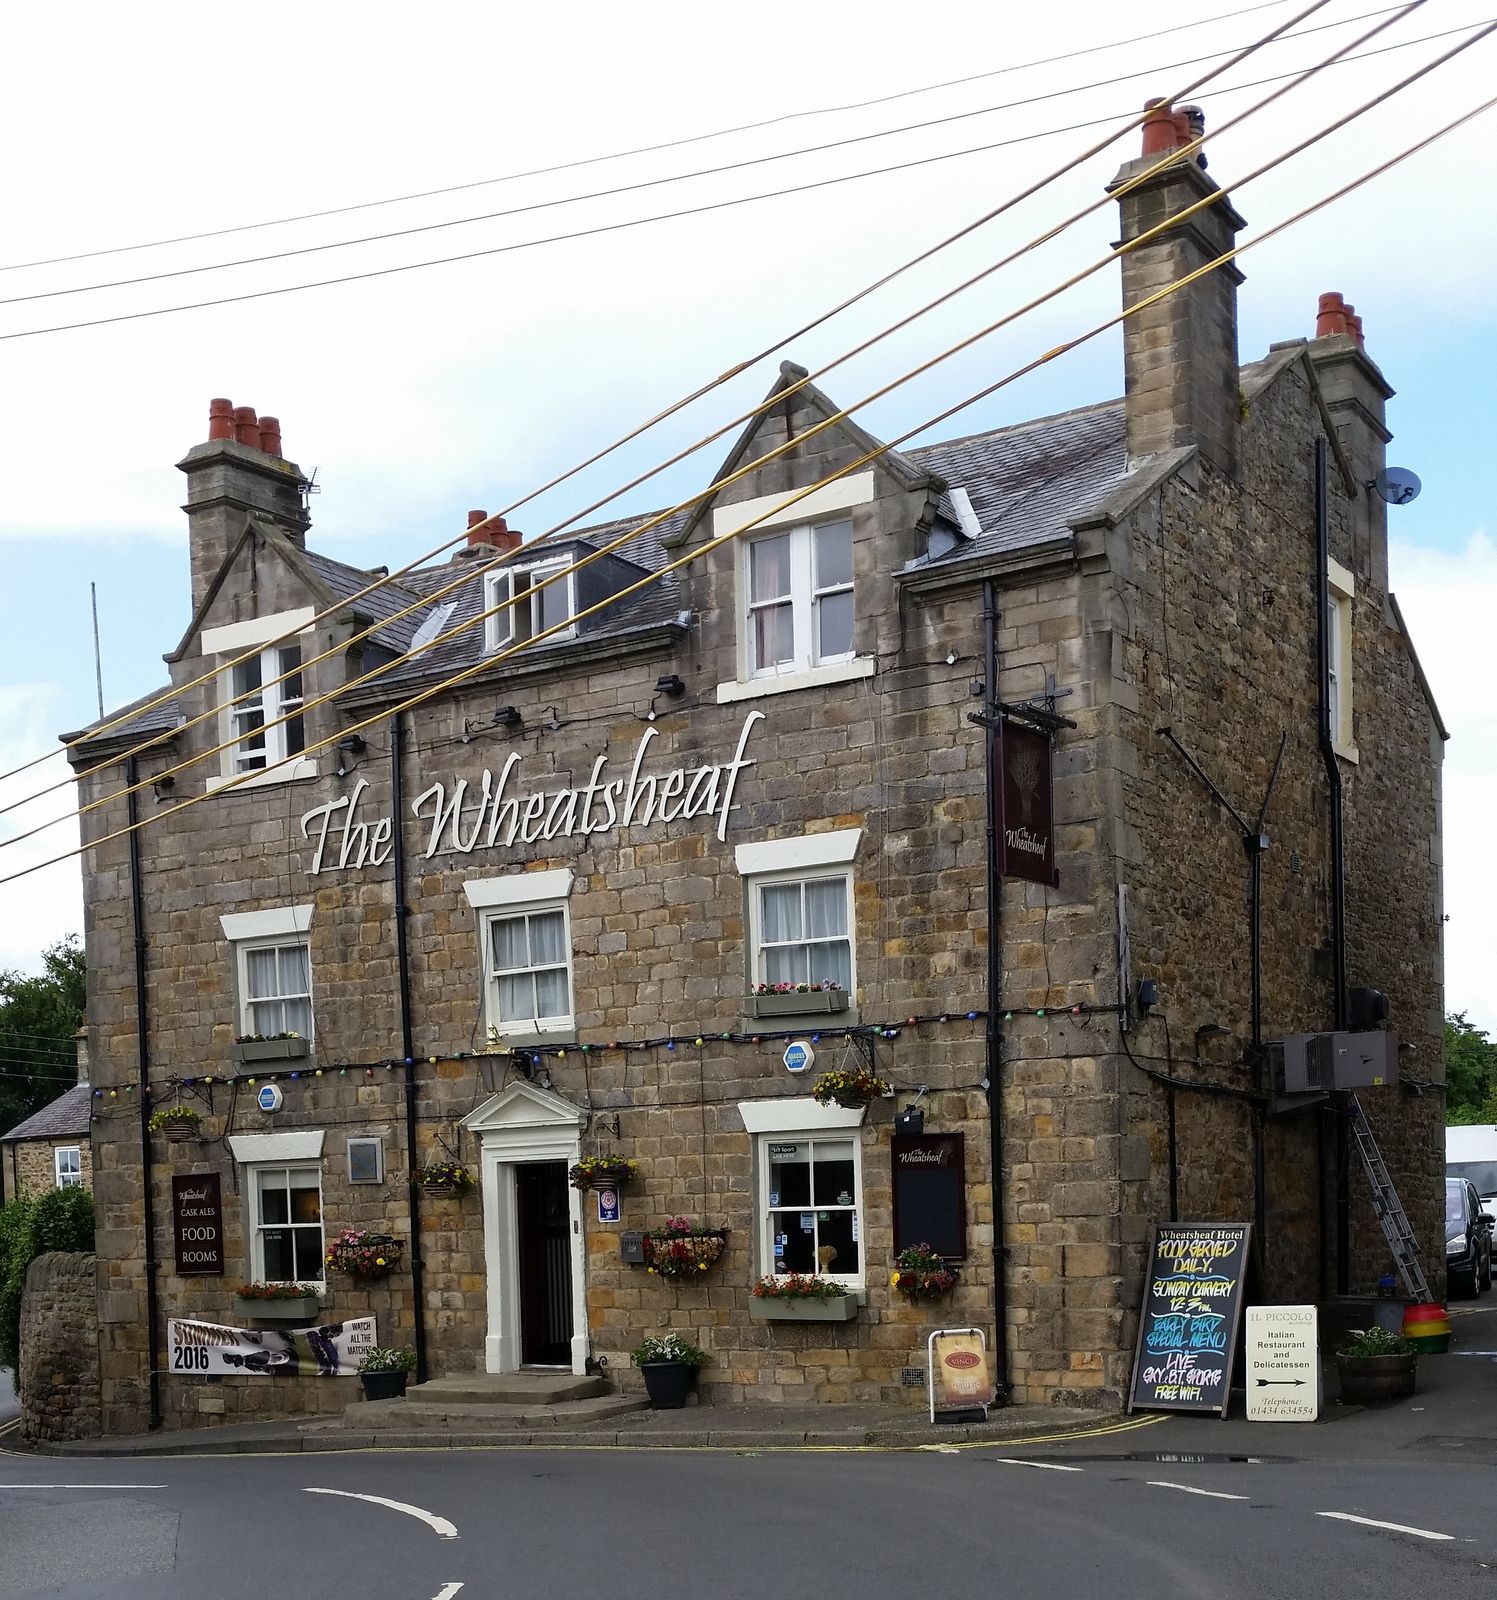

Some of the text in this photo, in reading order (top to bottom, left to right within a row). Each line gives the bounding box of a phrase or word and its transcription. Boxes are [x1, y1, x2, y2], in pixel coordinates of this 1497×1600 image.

[301, 710, 766, 875] The Wheatsheaf
[1006, 829, 1047, 861] Wheatsheaf
[899, 1150, 944, 1164] Wheatsheaf
[181, 1207, 215, 1216] CASK ALES
[182, 1226, 216, 1241] FOOD
[1160, 1230, 1243, 1240] Wheatsheaf Hotel
[1157, 1239, 1237, 1258] FOOD SERVED
[182, 1251, 218, 1262] ROOMS
[1152, 1280, 1236, 1297] SUNDAY CARVERY
[1250, 1312, 1313, 1321] IL PICCOLO
[352, 1322, 371, 1331] WATCH
[1154, 1317, 1222, 1332] EARLY BIRD
[350, 1334, 371, 1343] ALL THE
[1146, 1331, 1227, 1347] SPECIAL MENU
[1257, 1341, 1306, 1349] Restaurant
[174, 1346, 209, 1370] 2016
[1166, 1353, 1198, 1370] LIVE
[1253, 1361, 1310, 1369] Delicatessen
[1142, 1367, 1166, 1384] SKY
[1186, 1369, 1223, 1387] SPORTS
[1154, 1385, 1180, 1401] FREE
[1262, 1397, 1302, 1407] Telephone:
[1250, 1406, 1314, 1415] 01434 634554
